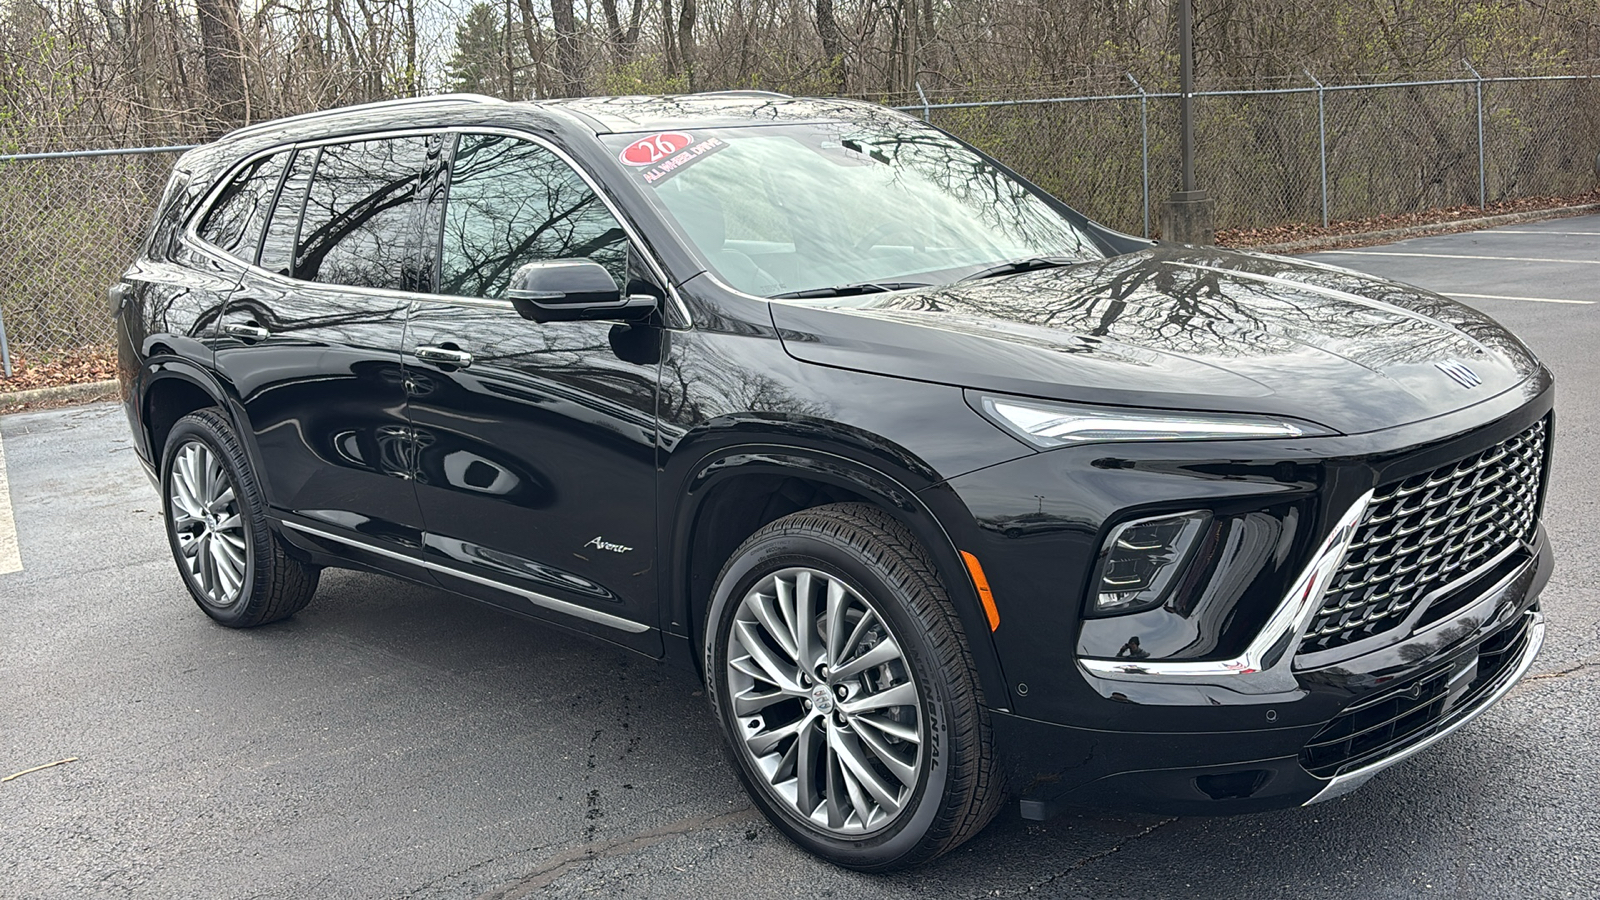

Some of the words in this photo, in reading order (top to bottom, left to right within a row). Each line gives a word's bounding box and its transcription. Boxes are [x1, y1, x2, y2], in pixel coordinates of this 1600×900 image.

[637, 133, 676, 162] 26
[642, 168, 667, 184] ALL
[658, 151, 697, 173] WHEEL
[690, 137, 723, 155] DRIVE
[907, 637, 940, 771] NTINENTAL
